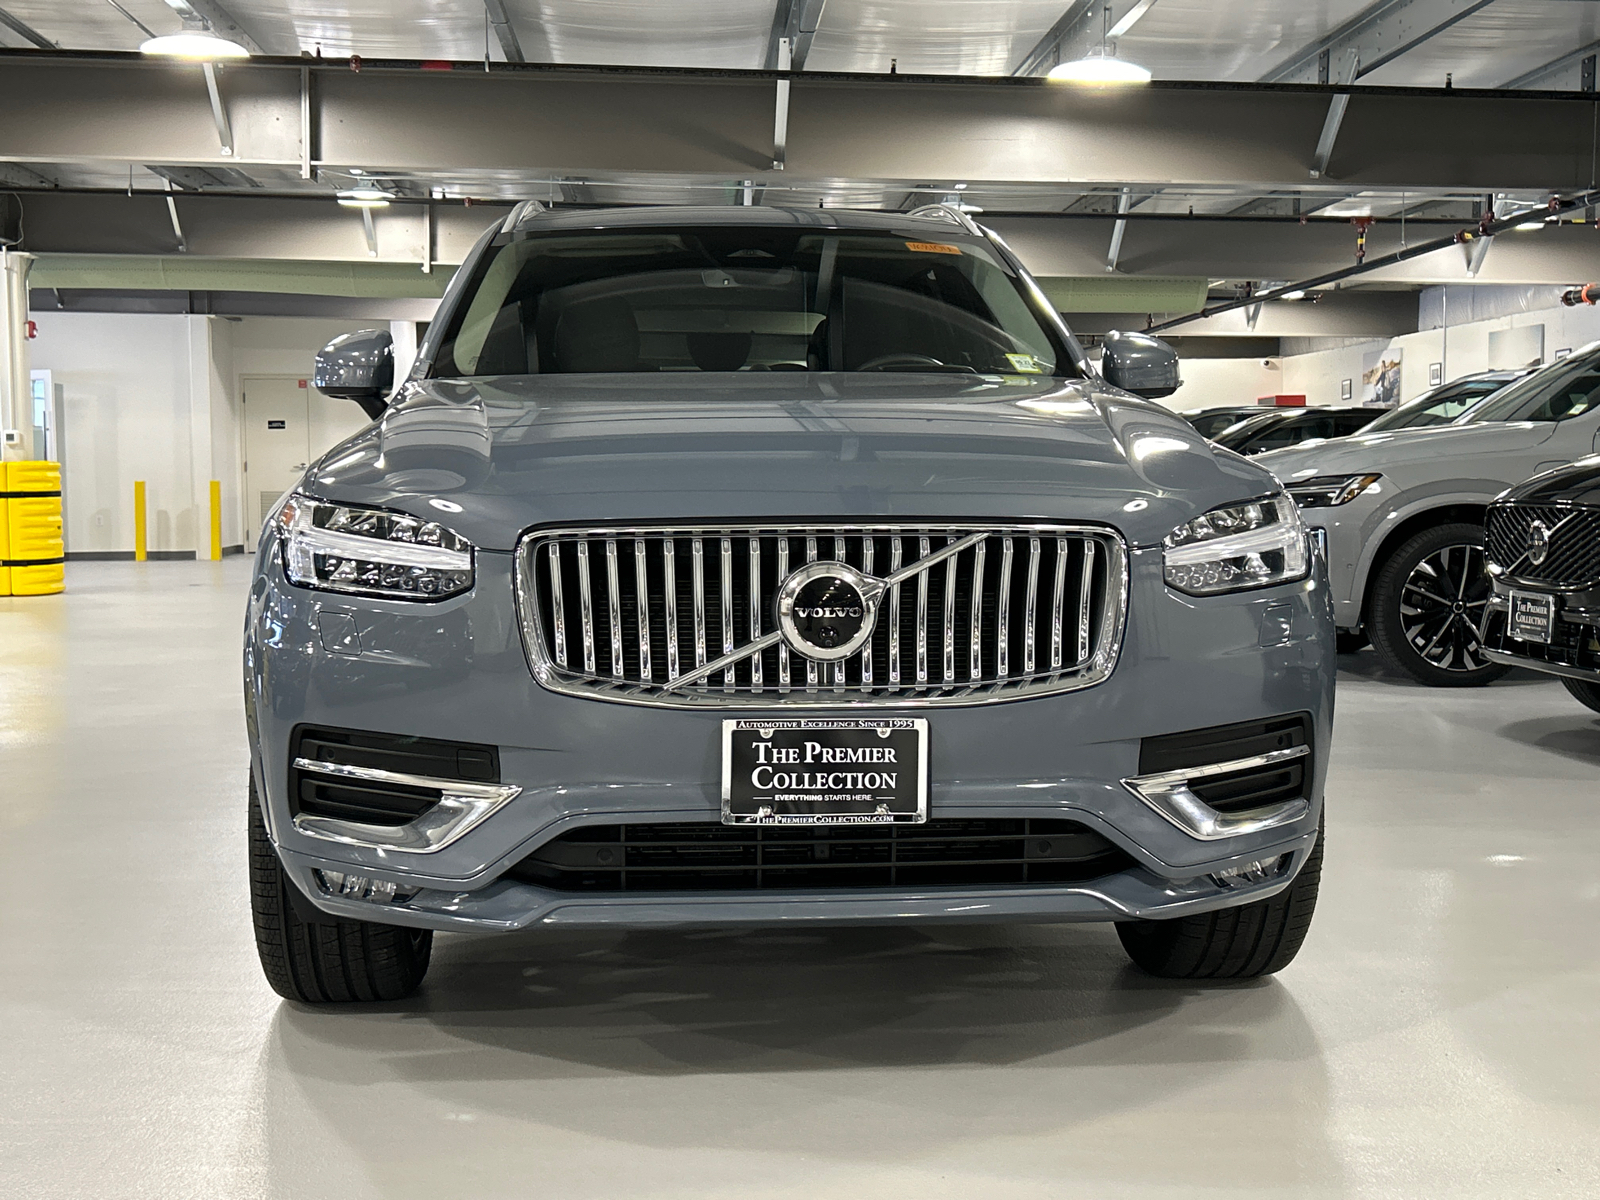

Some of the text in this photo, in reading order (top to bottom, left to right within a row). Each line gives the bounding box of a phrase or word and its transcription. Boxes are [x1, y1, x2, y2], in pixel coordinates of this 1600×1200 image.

[795, 607, 862, 618] VOLVO
[889, 720, 912, 728] 1995
[752, 742, 898, 763] THE PREMIER
[752, 766, 898, 789] COLLECTION
